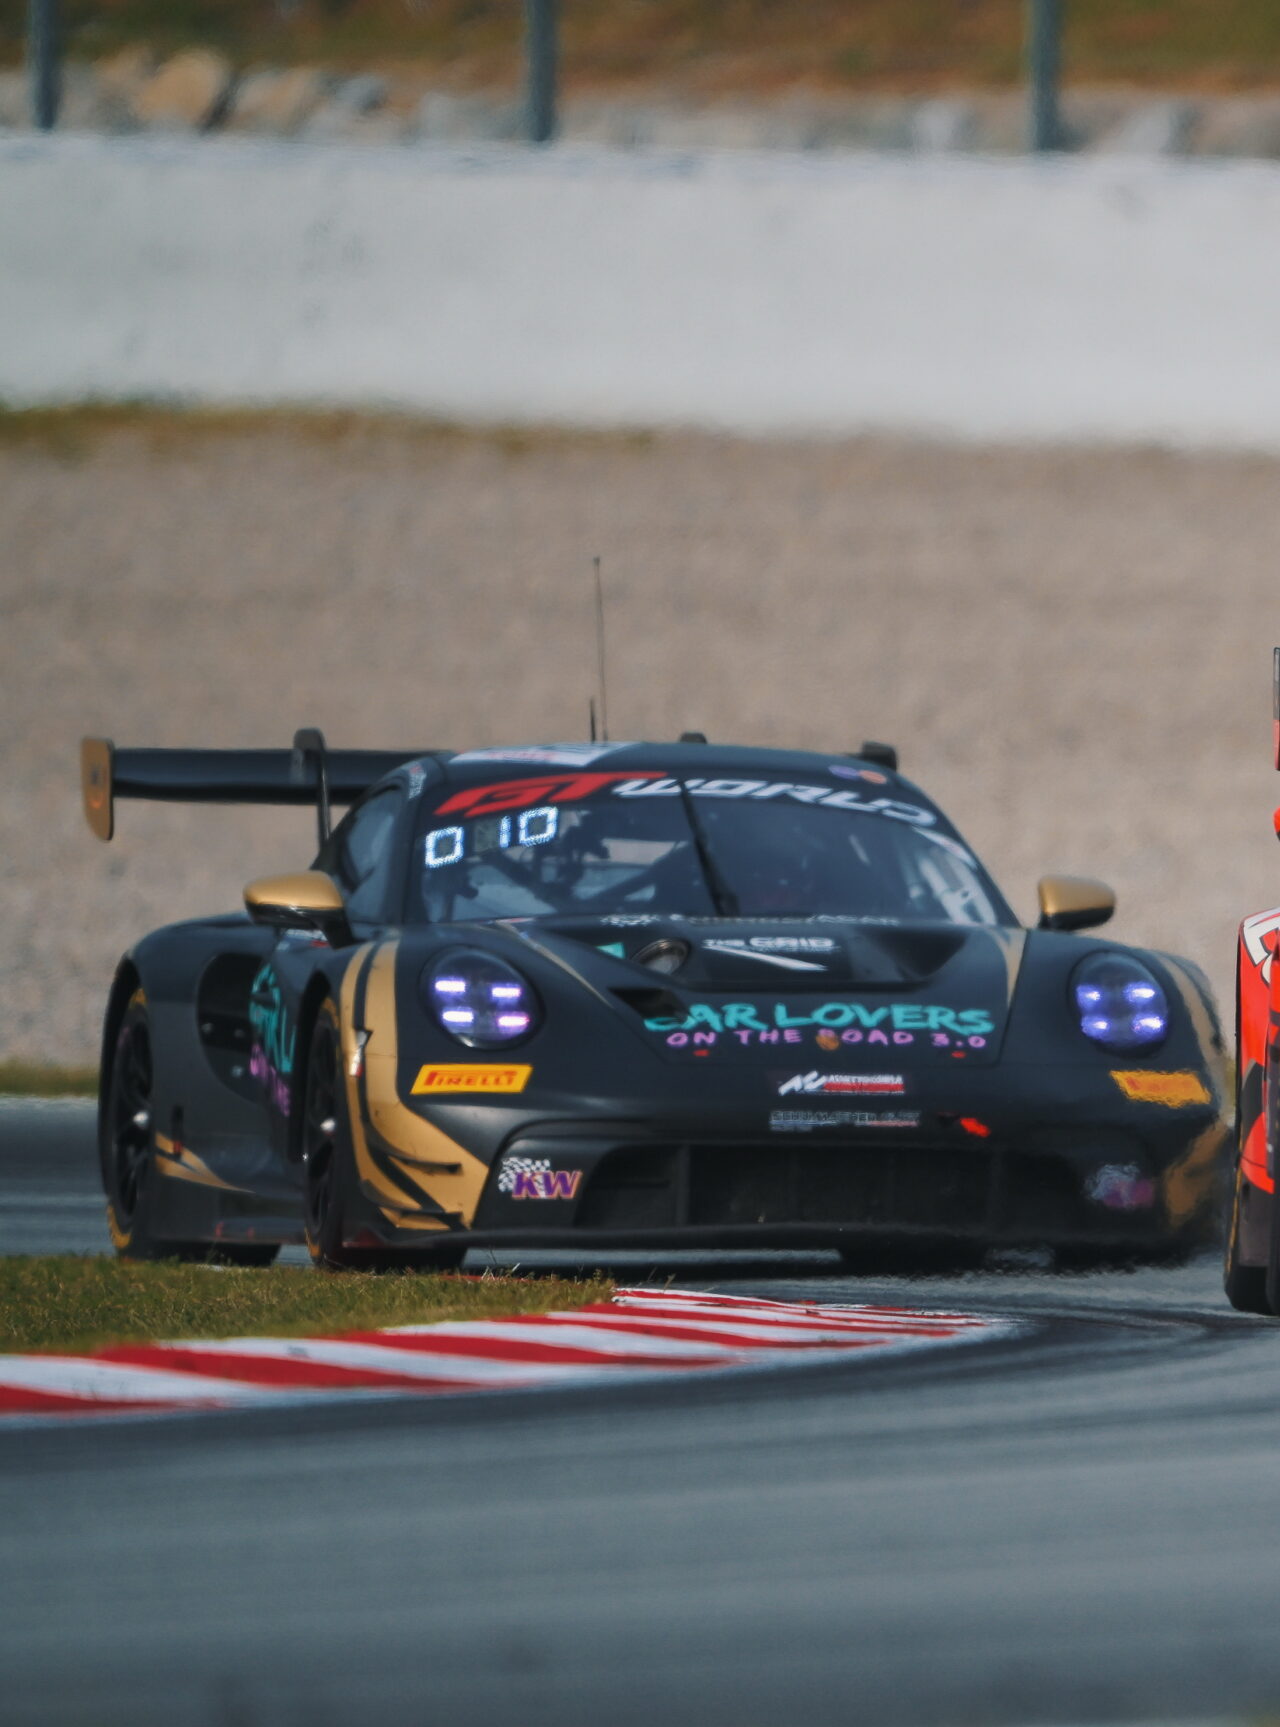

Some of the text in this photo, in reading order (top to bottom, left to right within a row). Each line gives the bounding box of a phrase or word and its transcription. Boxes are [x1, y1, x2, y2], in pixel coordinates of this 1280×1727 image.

[433, 770, 668, 818] GT
[612, 778, 937, 827] WORLD
[424, 805, 560, 869] 010
[774, 1003, 996, 1035] LOVERS
[666, 1030, 717, 1046] ON
[734, 1027, 803, 1045] THE
[931, 1031, 987, 1049] 3.0
[423, 1069, 519, 1087] PIRELLI
[511, 1170, 583, 1199] KW
